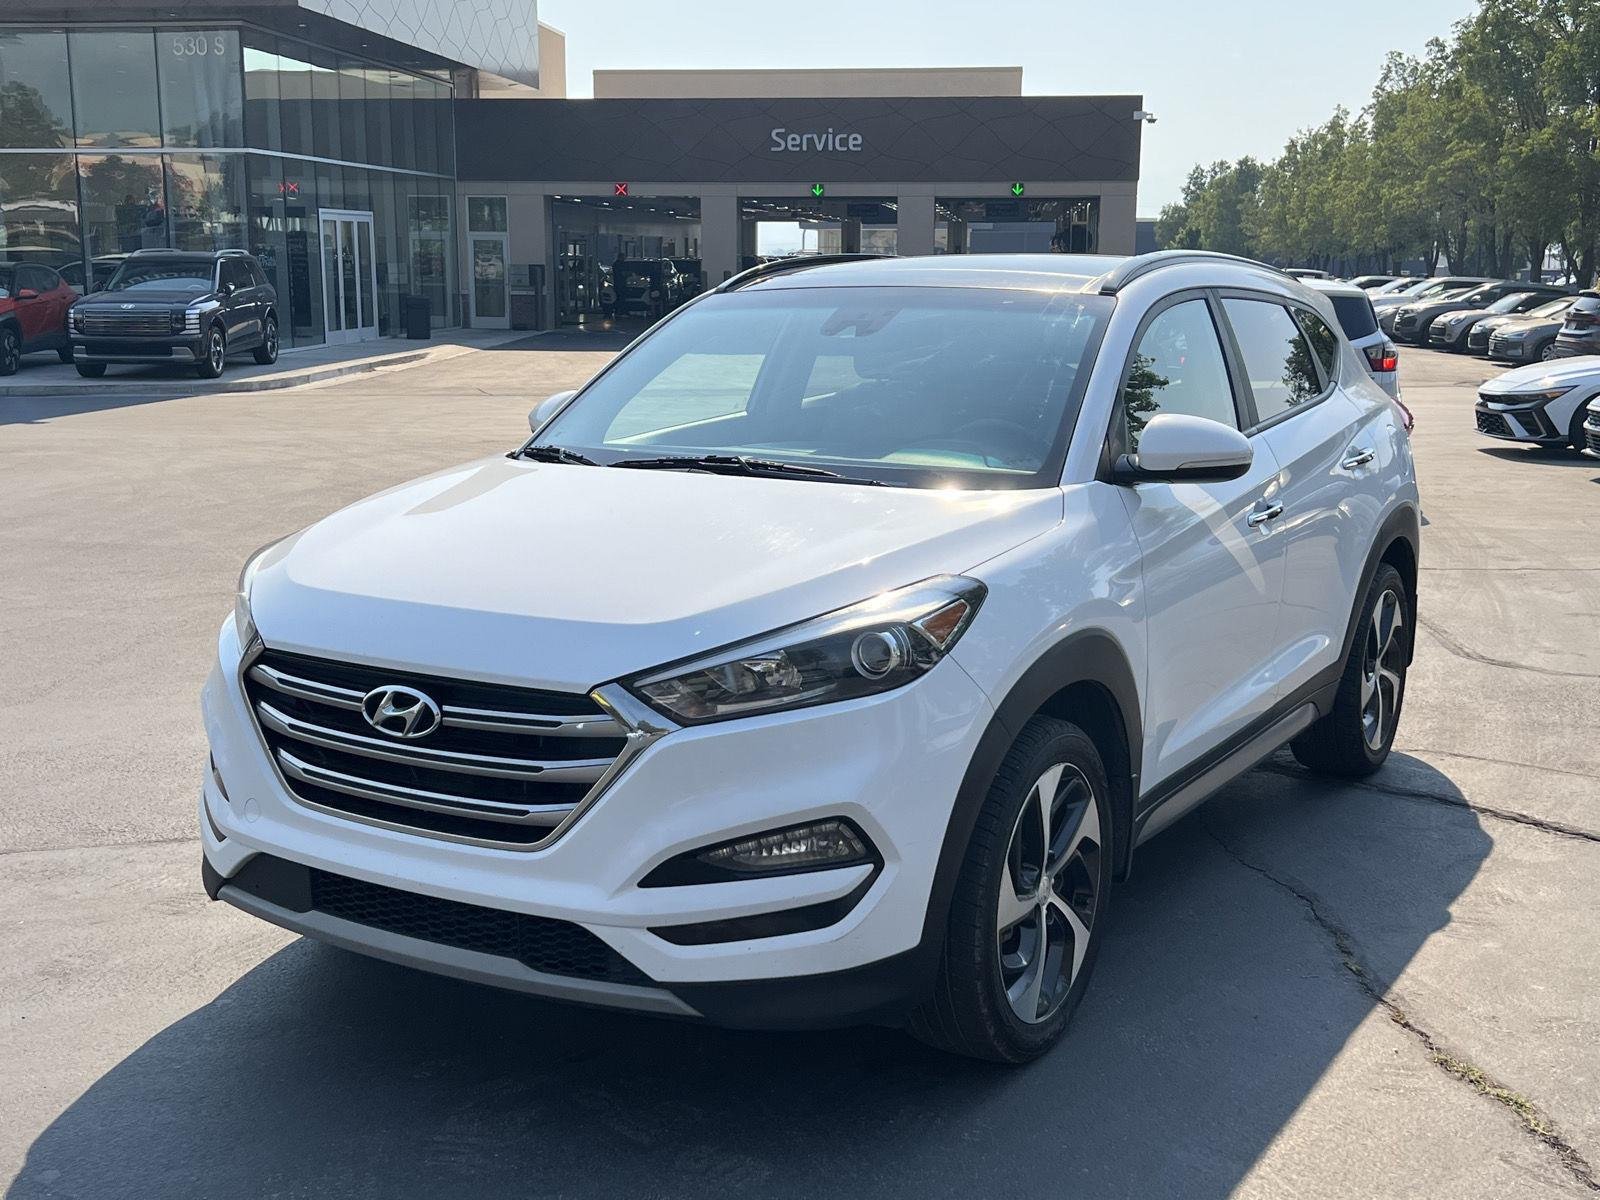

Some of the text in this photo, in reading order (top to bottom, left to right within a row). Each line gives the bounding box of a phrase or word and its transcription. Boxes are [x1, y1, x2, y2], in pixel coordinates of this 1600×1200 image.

[172, 36, 225, 56] 530 S
[770, 127, 863, 152] Service
